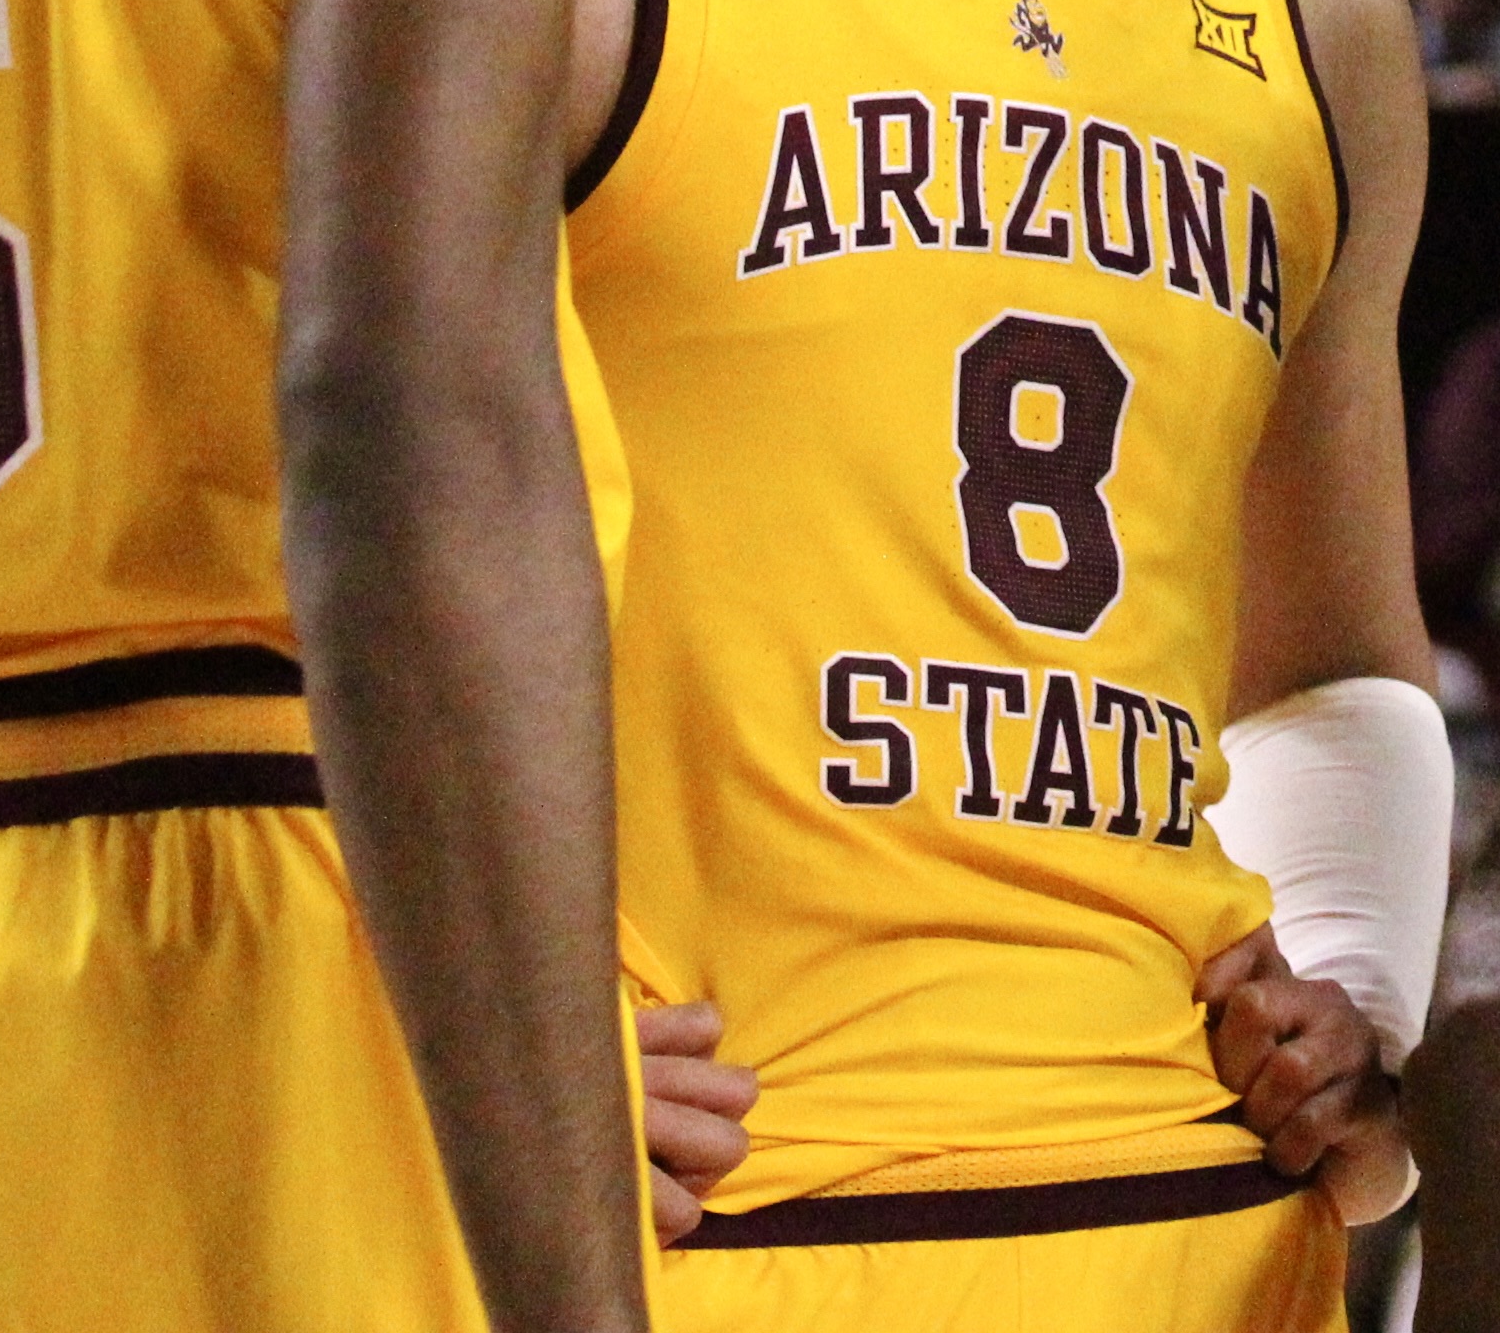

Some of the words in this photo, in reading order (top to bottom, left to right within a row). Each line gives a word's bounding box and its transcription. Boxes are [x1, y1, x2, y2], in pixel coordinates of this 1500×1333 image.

[736, 91, 1283, 361] ARIZONA
[953, 309, 1135, 639] 8
[820, 653, 1201, 850] STATE
